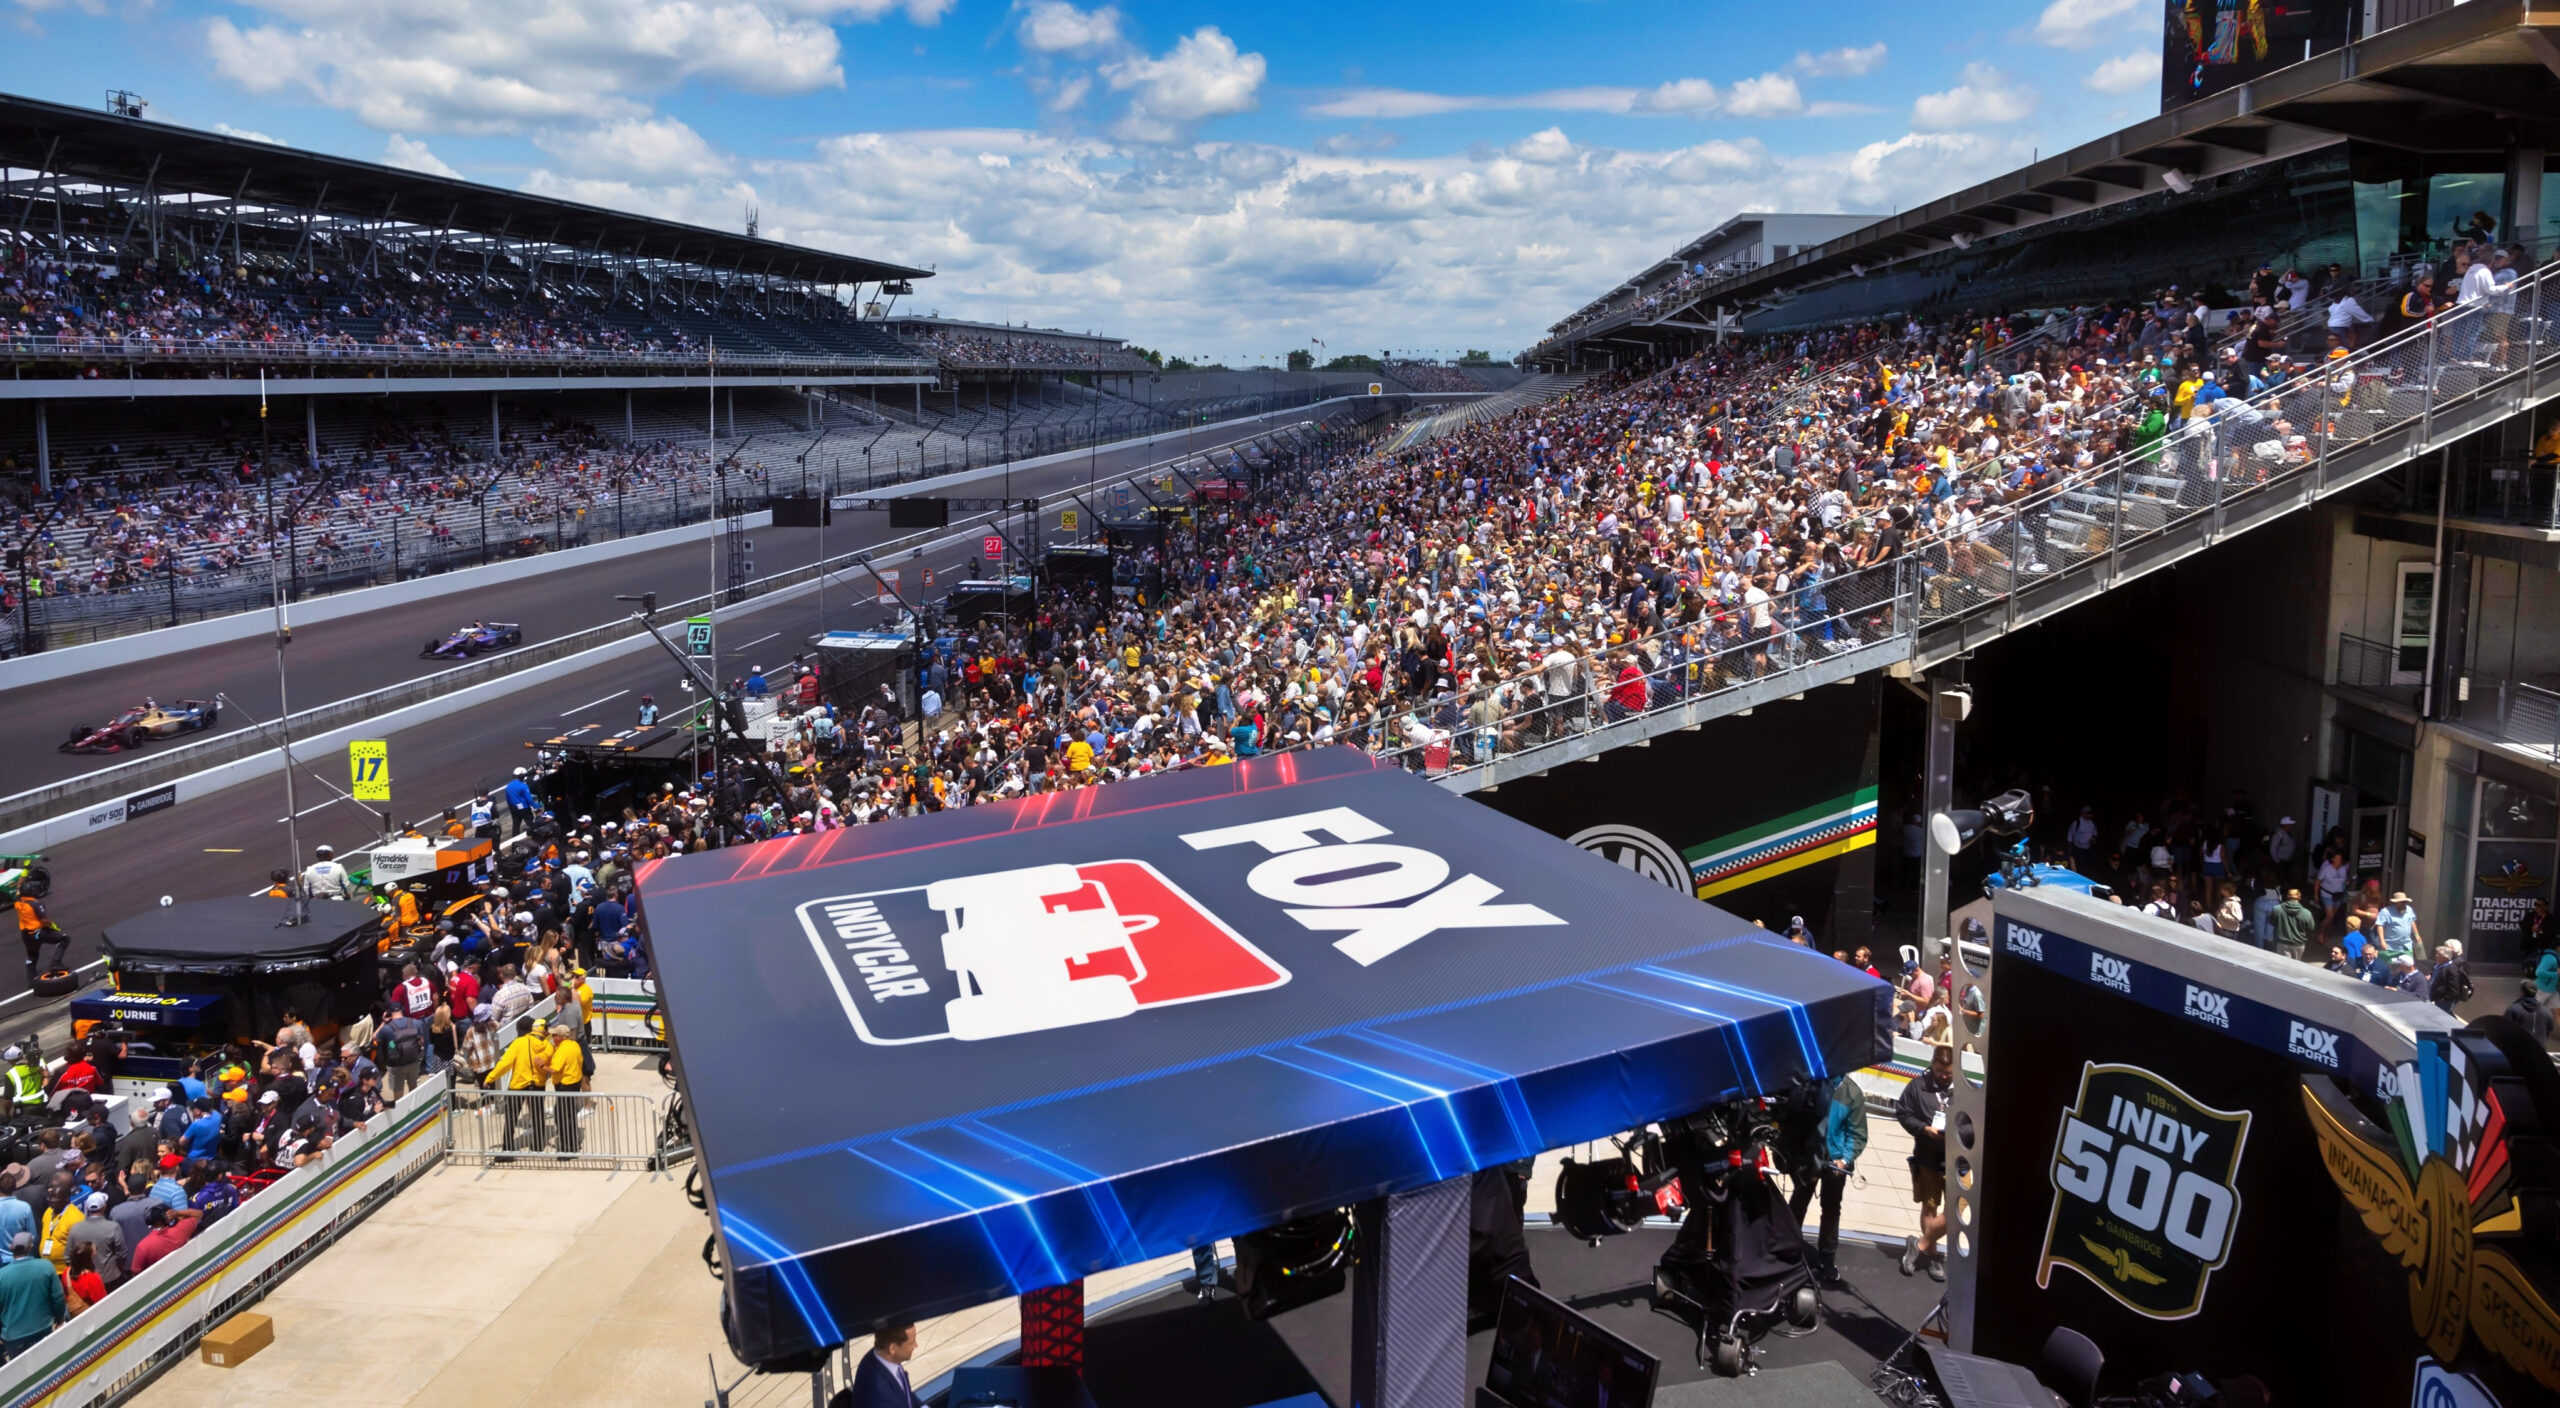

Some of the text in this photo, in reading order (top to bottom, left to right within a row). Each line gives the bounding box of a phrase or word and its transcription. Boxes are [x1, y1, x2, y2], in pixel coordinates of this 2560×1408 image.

[1116, 493, 1127, 506] 6
[1063, 514, 1076, 524] 26
[985, 540, 1000, 551] 27
[356, 757, 384, 782] 17
[136, 791, 174, 811] GAINBRIDGE
[89, 807, 124, 827] INDY 500
[373, 854, 409, 865] Hendrick
[446, 871, 460, 883] 17
[1178, 806, 1570, 967] FOX
[2473, 897, 2537, 909] TRACKSID
[2472, 908, 2526, 922] OFFICI
[2471, 922, 2521, 931] MERCHAN
[2007, 923, 2043, 954] FOX
[824, 900, 930, 1001] INDYCAR
[2006, 942, 2043, 961] SPORTS
[2091, 952, 2131, 985] FOX
[2090, 972, 2131, 993] SPORTS
[102, 995, 189, 1006] JOURNIE
[2185, 984, 2230, 1019] FOX
[110, 1009, 157, 1021] JOURNIE
[2184, 1006, 2229, 1029] SPORTS
[2289, 1020, 2339, 1058] FOX
[2288, 1043, 2338, 1068] SPORTS
[2146, 1092, 2177, 1114] 109TH
[2376, 1087, 2392, 1104] SPO
[2106, 1094, 2210, 1164] INDY
[2056, 1116, 2234, 1262] 500
[2328, 1141, 2421, 1246] INDIANAPOLIS
[2106, 1220, 2163, 1259] GAINBRIDGE
[2438, 1192, 2466, 1348] MOTOR
[2480, 1281, 2560, 1373] SPEEDWA
